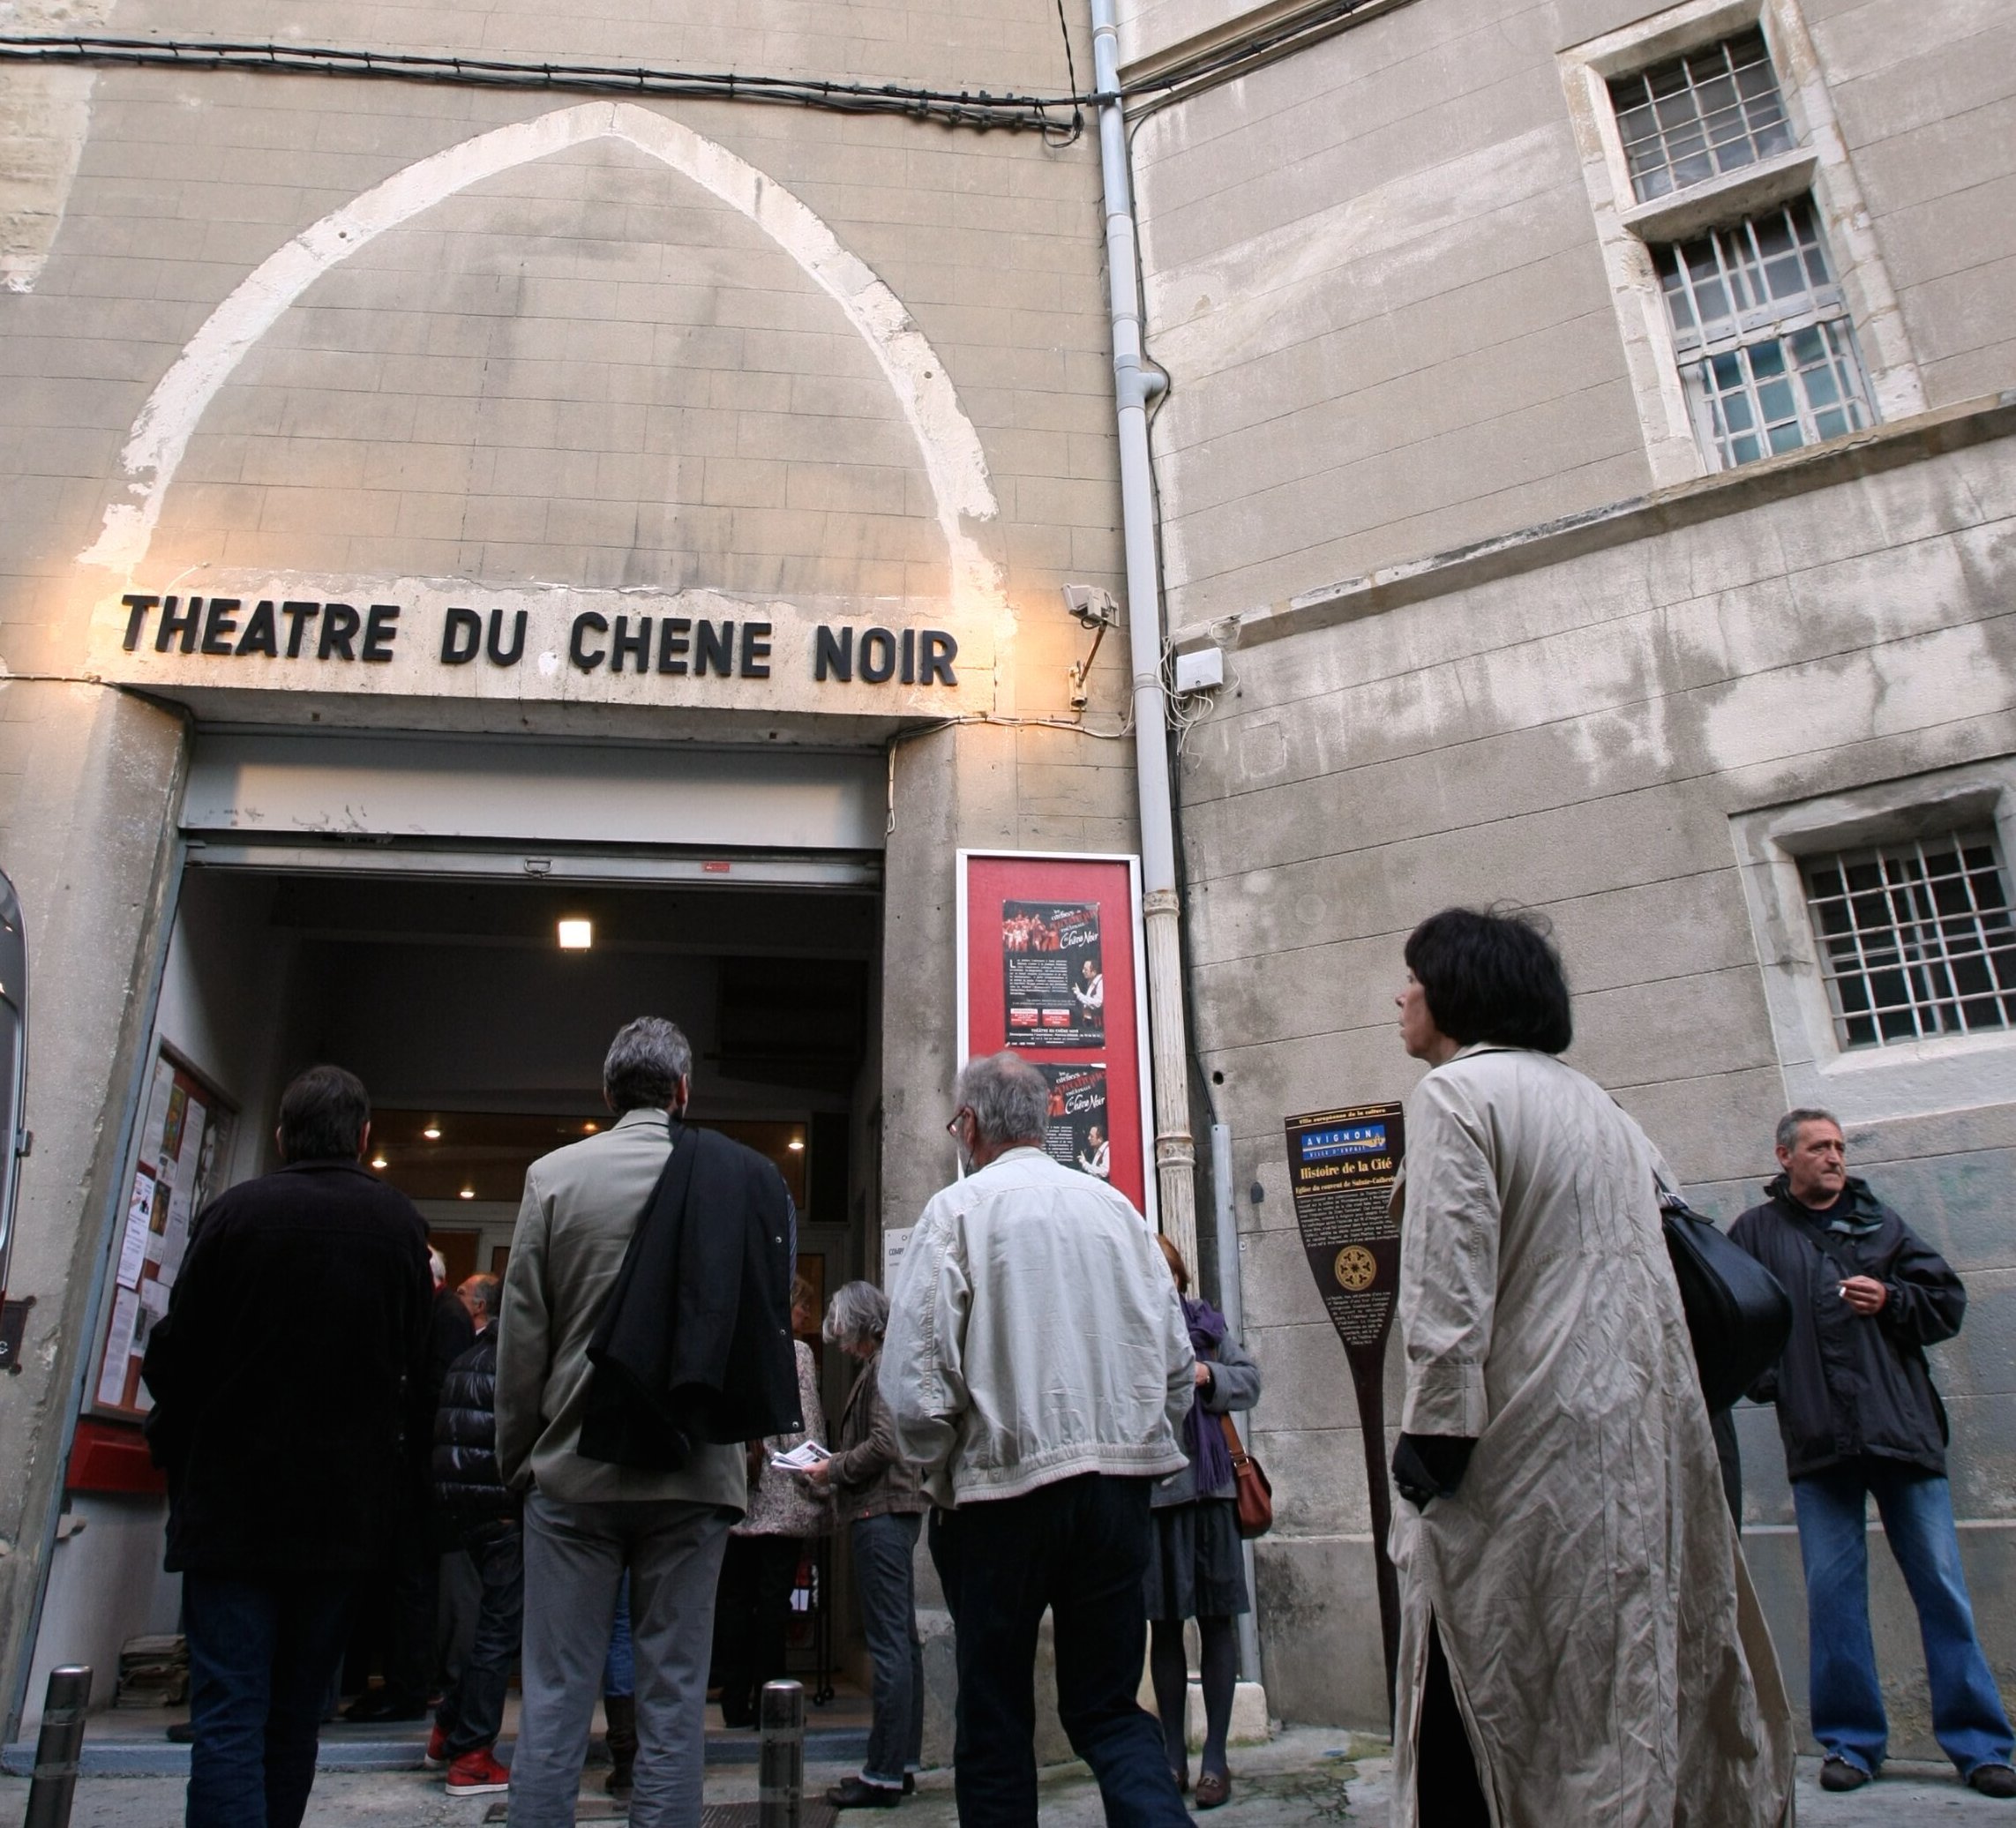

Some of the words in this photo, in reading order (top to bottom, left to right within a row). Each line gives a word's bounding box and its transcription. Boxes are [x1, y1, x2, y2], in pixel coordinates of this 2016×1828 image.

[122, 594, 401, 663] THEATRE
[440, 607, 528, 668] DU
[569, 611, 773, 679] CHENE
[815, 624, 959, 687] NOIR
[1307, 1129, 1372, 1146] AVIGNON
[1300, 1165, 1339, 1180] Histoire
[1342, 1162, 1355, 1173] de
[1358, 1161, 1368, 1172] la
[1370, 1157, 1393, 1171] Cité
